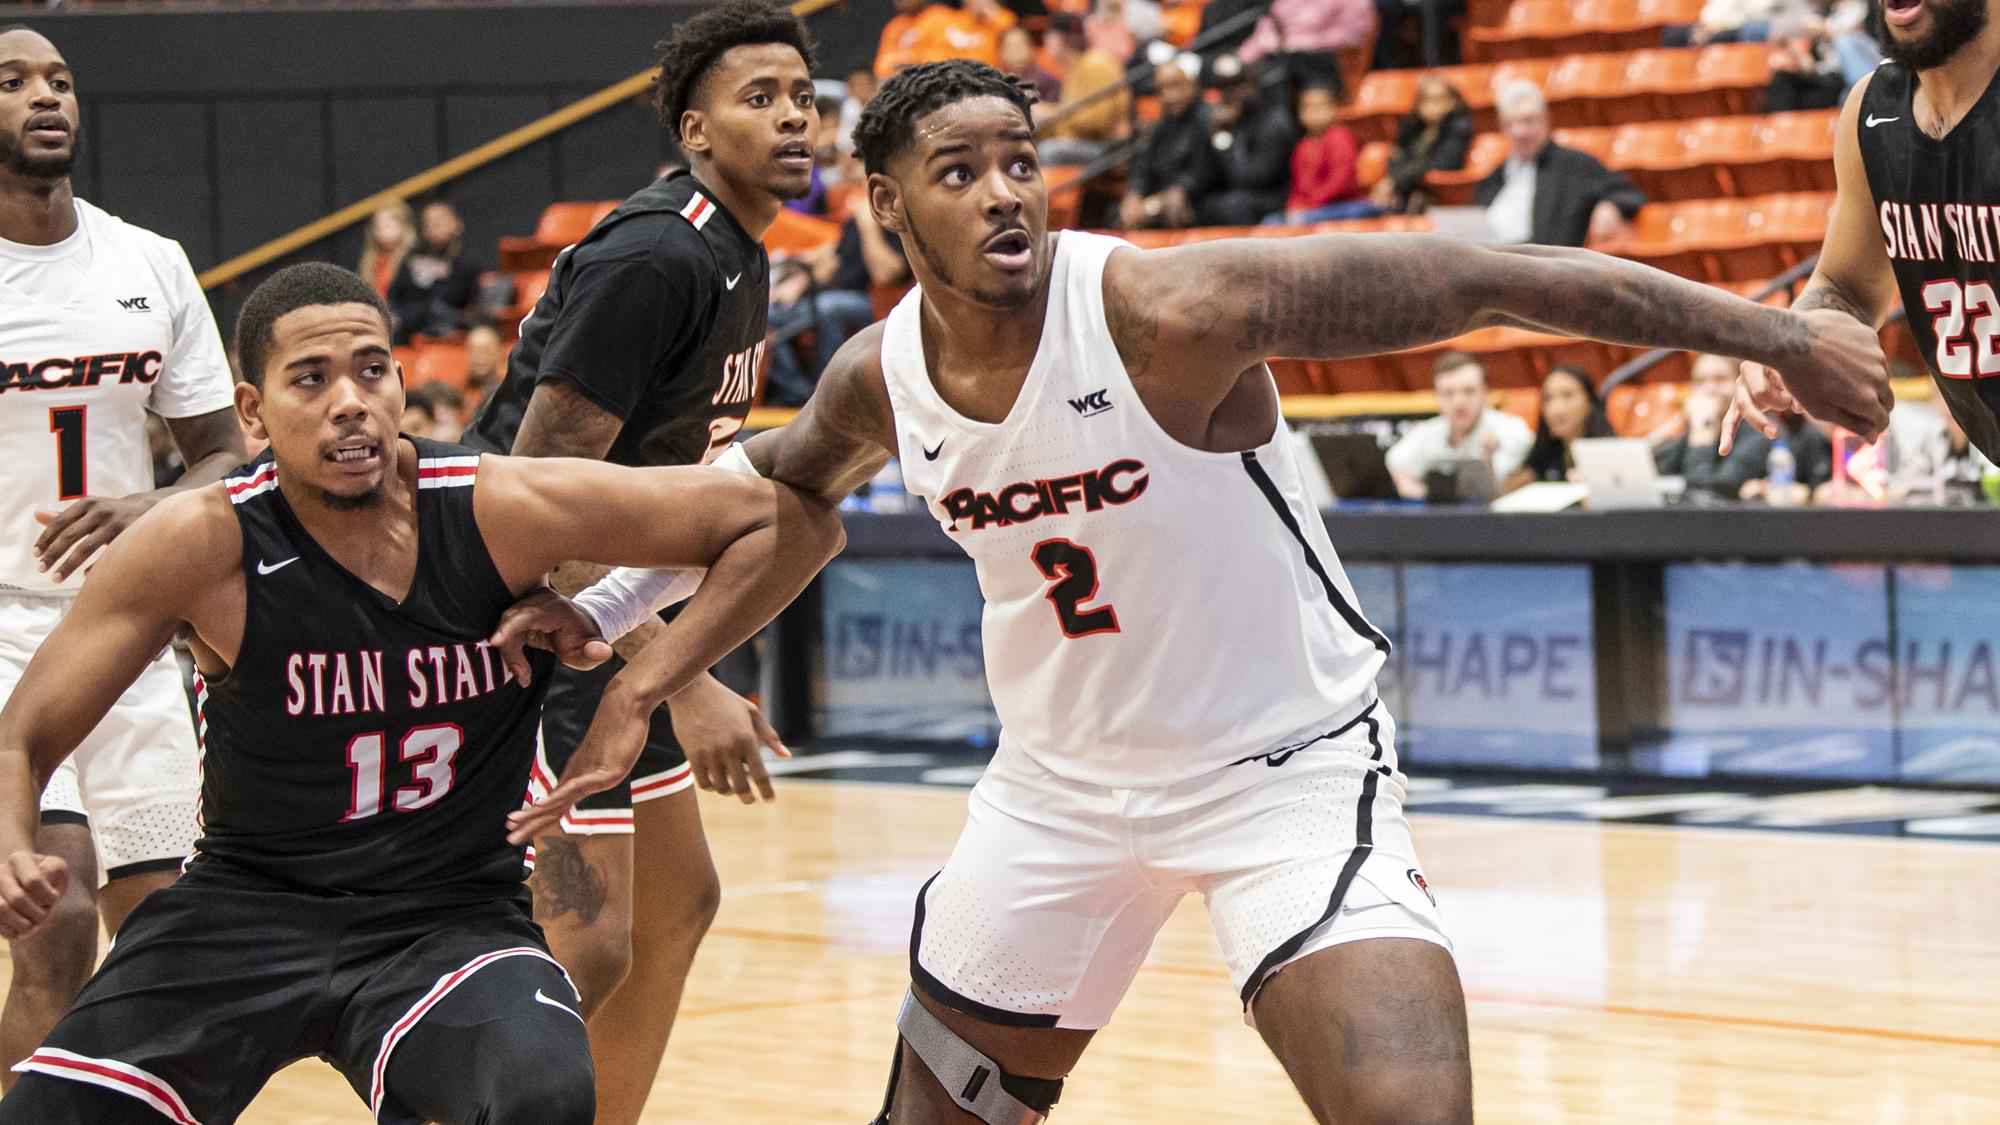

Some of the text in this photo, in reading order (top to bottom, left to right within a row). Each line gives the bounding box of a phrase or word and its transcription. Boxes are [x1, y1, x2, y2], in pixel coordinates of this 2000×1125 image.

[1880, 200, 1945, 262] STAN
[117, 297, 151, 311] WCC
[1920, 278, 2000, 379] 22
[0, 349, 163, 394] ACIFIC
[1067, 388, 1113, 416] WCC
[49, 404, 87, 501] 1
[939, 458, 1149, 532] PACIFIC
[1031, 537, 1121, 639] 2
[286, 650, 386, 716] STAN
[338, 722, 464, 823] 13
